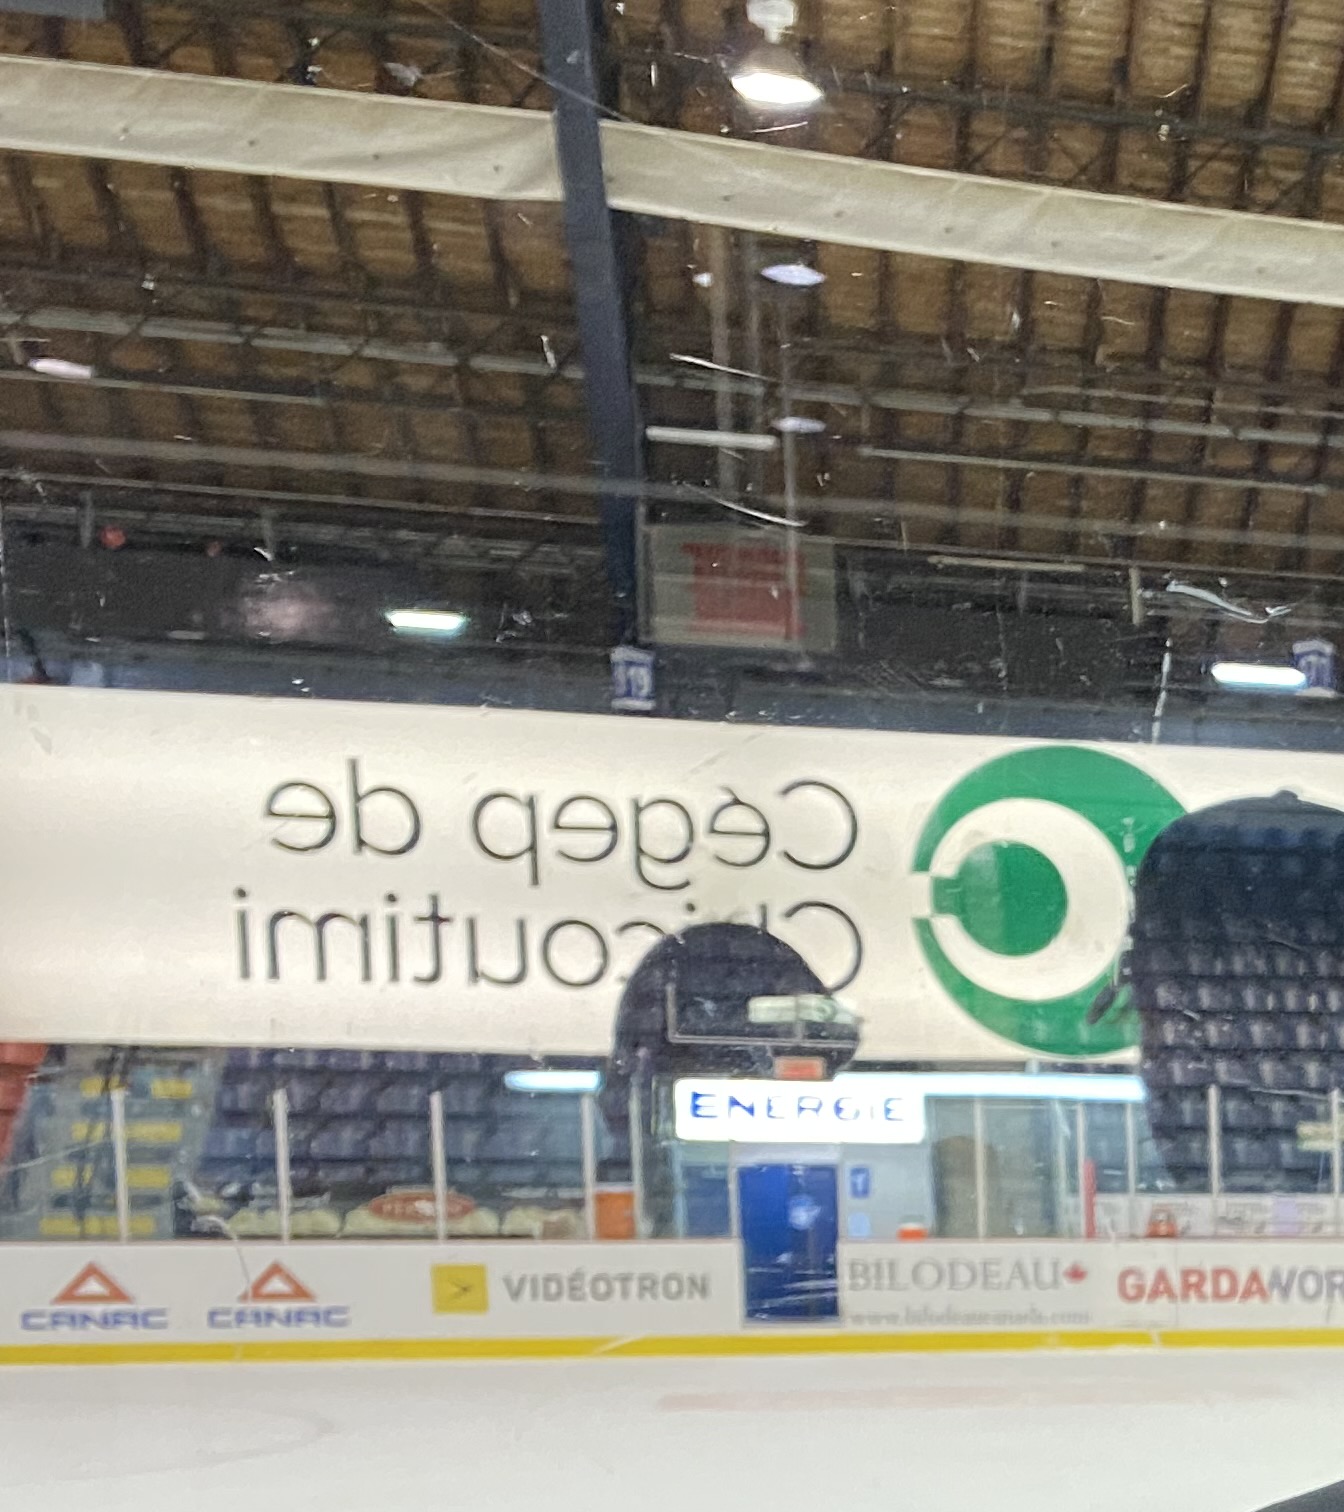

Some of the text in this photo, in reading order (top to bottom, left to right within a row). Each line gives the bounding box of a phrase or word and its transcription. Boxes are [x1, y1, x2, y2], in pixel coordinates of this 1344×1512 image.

[501, 1266, 713, 1303] VIDÉOTRON
[848, 1257, 1062, 1292] BILODEAU
[20, 1307, 170, 1331] CANAC
[206, 1305, 352, 1329] CANAC
